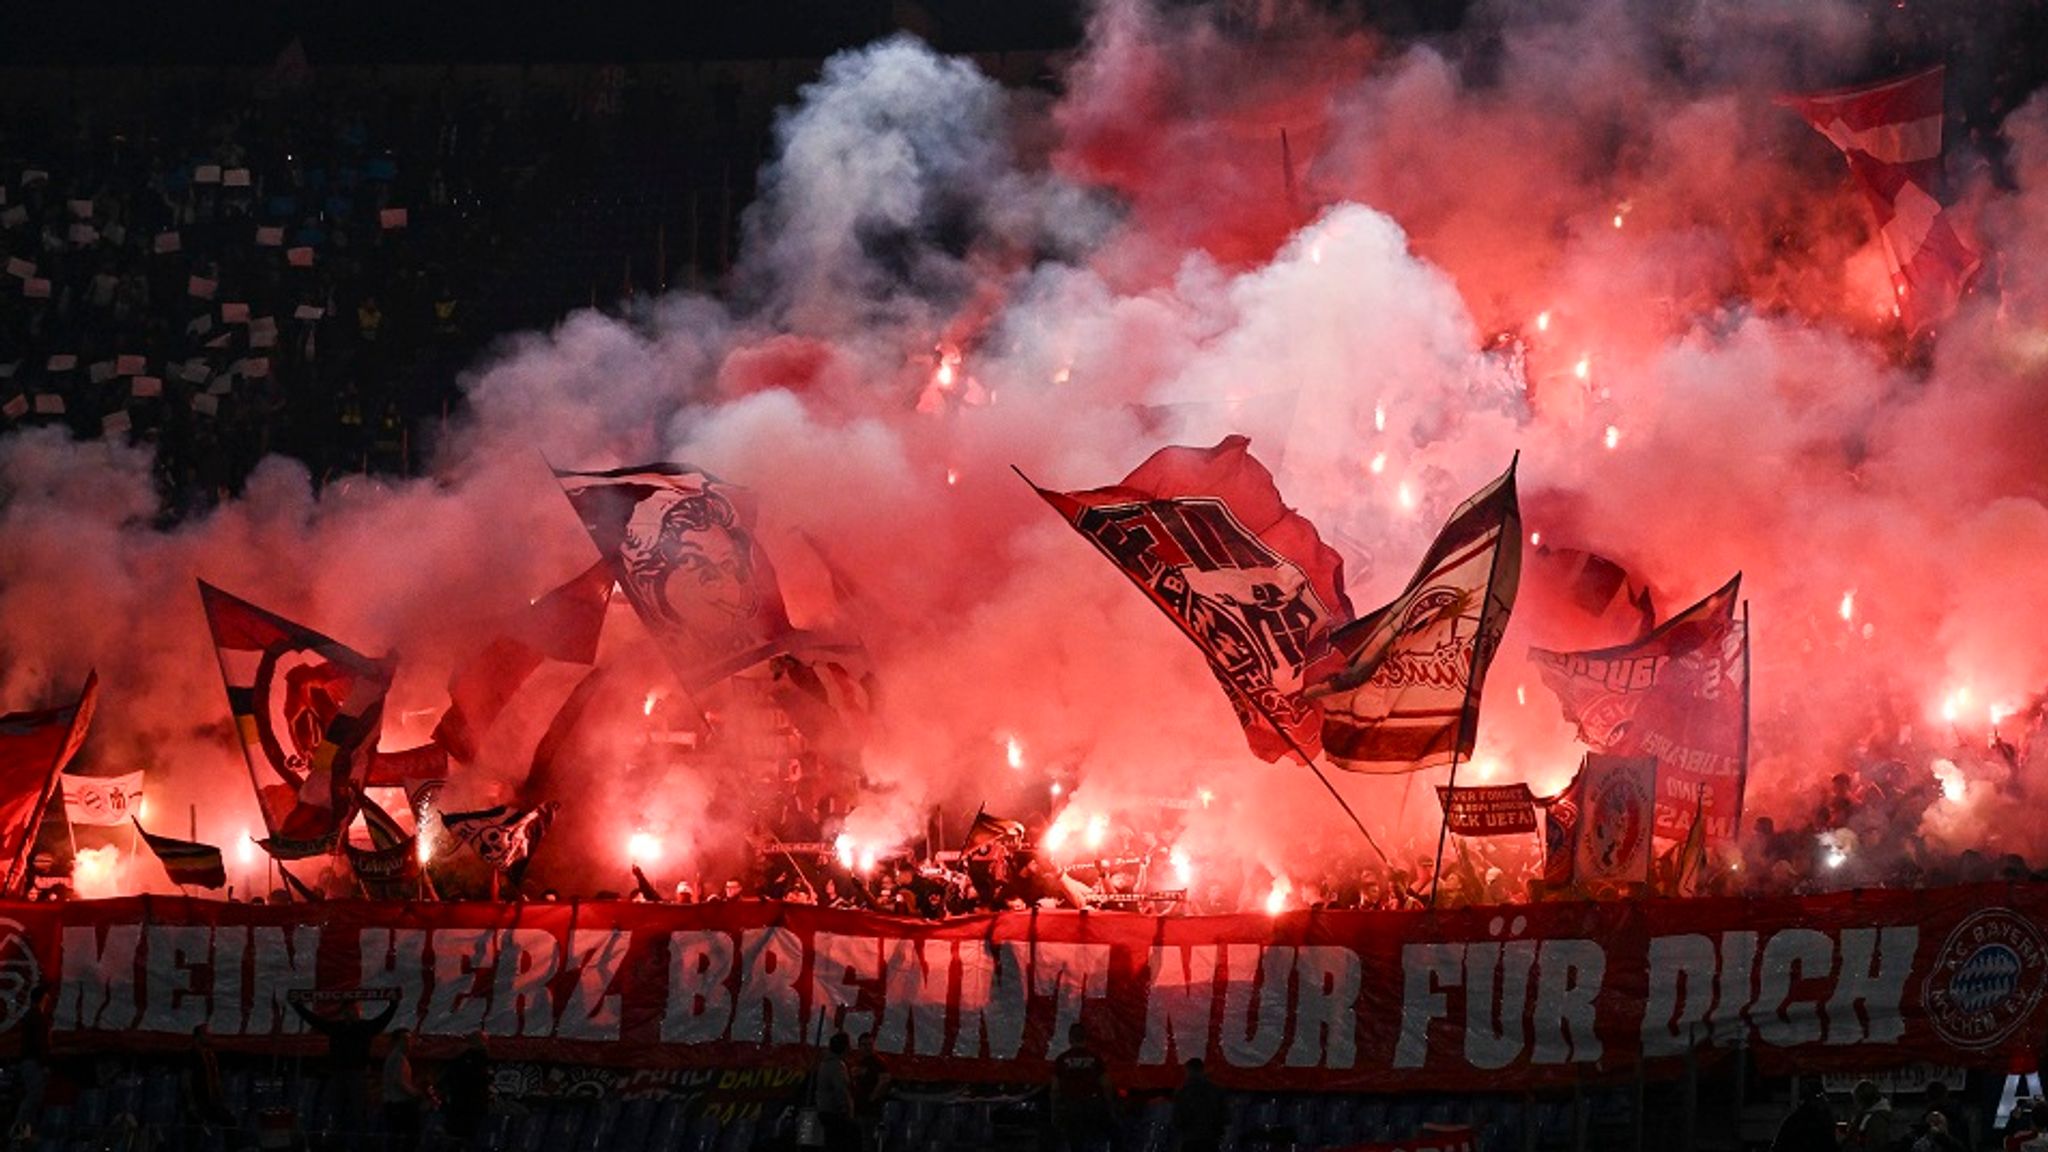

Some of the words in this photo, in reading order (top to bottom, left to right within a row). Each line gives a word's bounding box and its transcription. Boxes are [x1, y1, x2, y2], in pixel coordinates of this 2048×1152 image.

[53, 924, 320, 1034] MEIN
[347, 926, 632, 1041] HERZ
[660, 928, 1109, 1060] BRENNT
[1138, 943, 1362, 1070] NUR
[1393, 914, 1606, 1070] FÜR
[1642, 925, 1920, 1058] DICH
